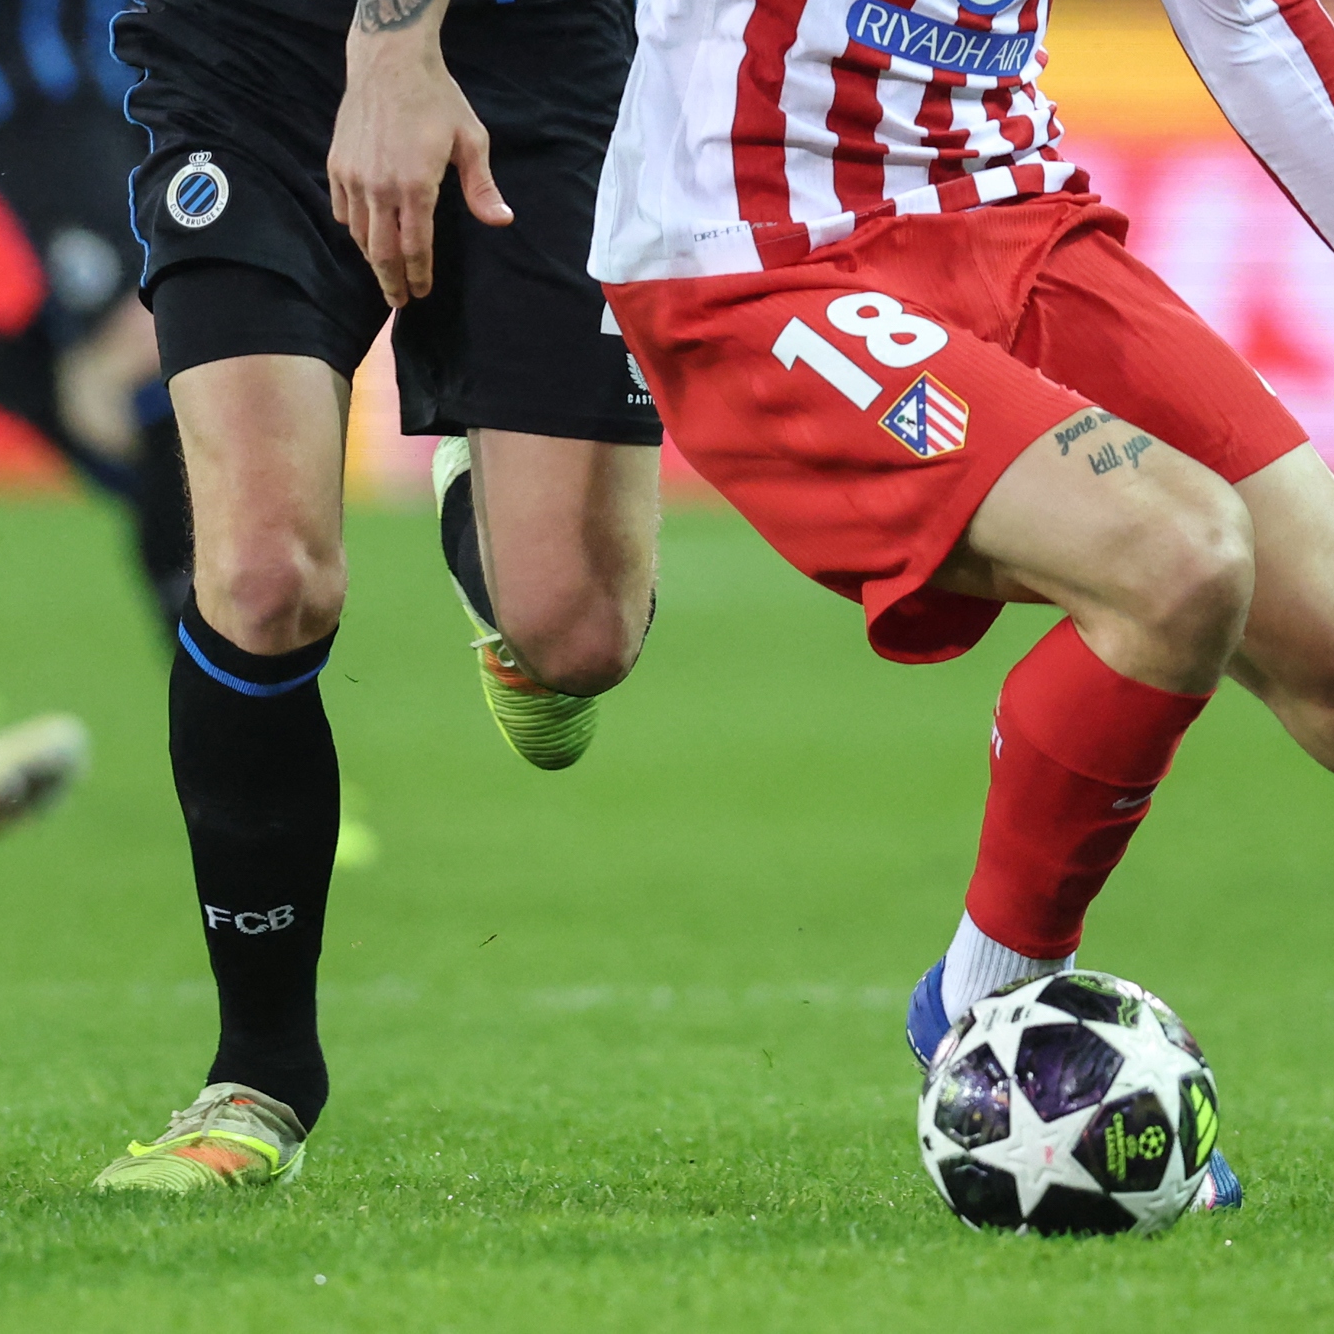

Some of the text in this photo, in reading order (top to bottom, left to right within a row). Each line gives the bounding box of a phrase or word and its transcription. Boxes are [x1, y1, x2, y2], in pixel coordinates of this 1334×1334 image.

[856, 2, 1030, 72] RIYADH AIR
[169, 203, 185, 222] CLUB
[185, 212, 216, 226] BRUGGE
[770, 291, 949, 412] 18
[1087, 434, 1153, 476] kill you
[204, 904, 295, 935] FCB
